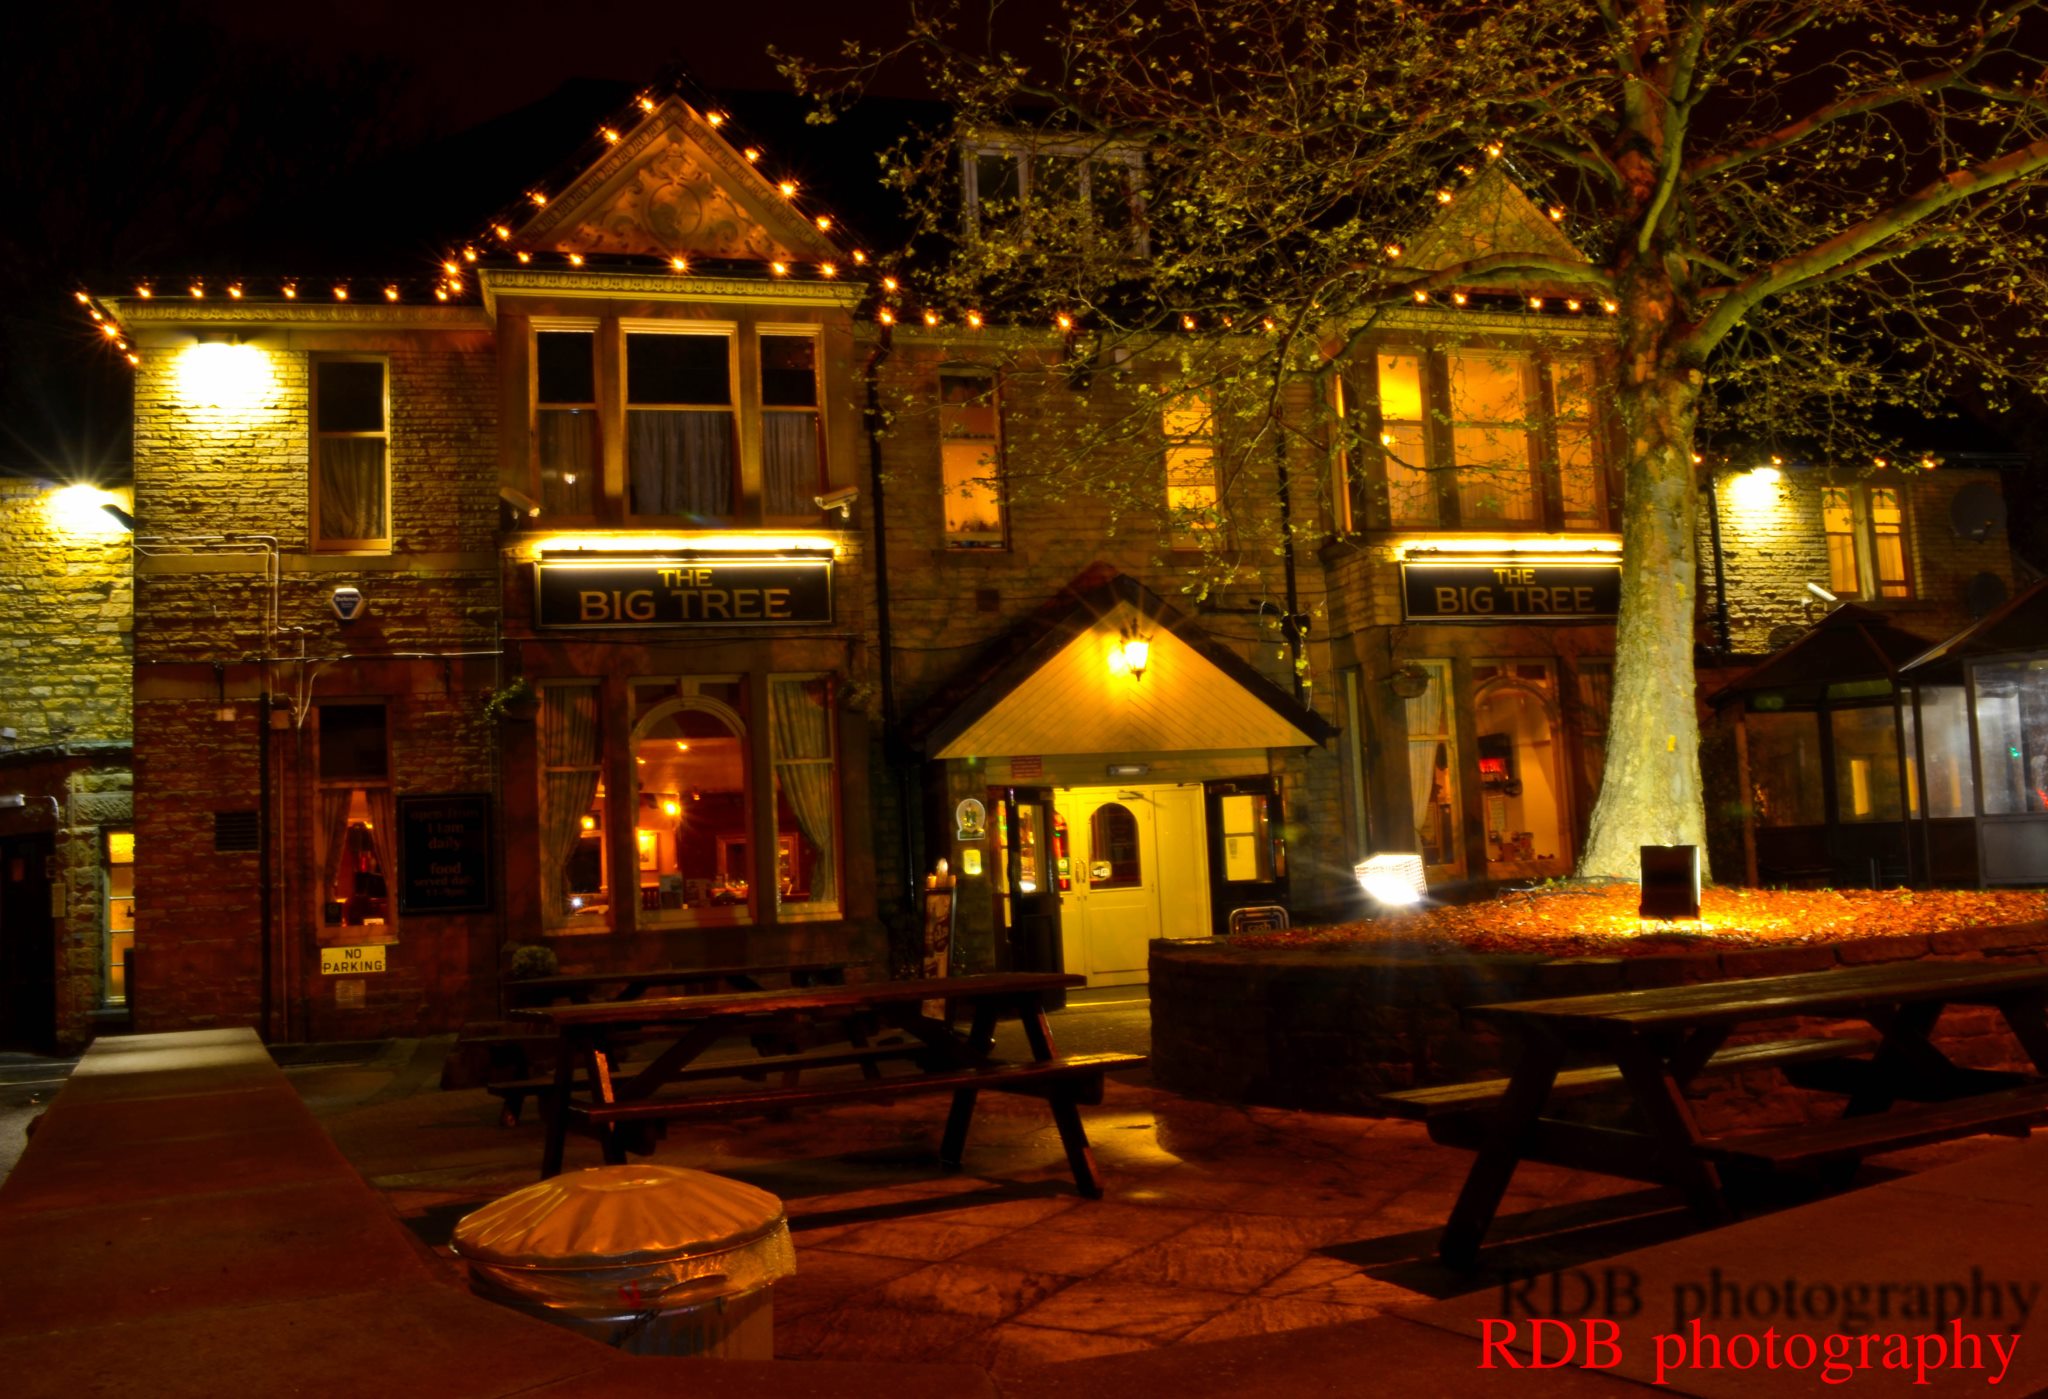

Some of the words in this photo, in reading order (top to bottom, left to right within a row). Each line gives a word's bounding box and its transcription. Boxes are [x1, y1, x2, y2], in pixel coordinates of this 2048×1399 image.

[657, 569, 712, 588] THE
[1493, 568, 1536, 585] THE
[579, 588, 656, 621] BIG
[670, 588, 792, 619] TREE
[1434, 586, 1494, 613] BIG
[1504, 586, 1596, 612] TREE
[345, 949, 361, 959] NO
[323, 960, 382, 973] PARKING
